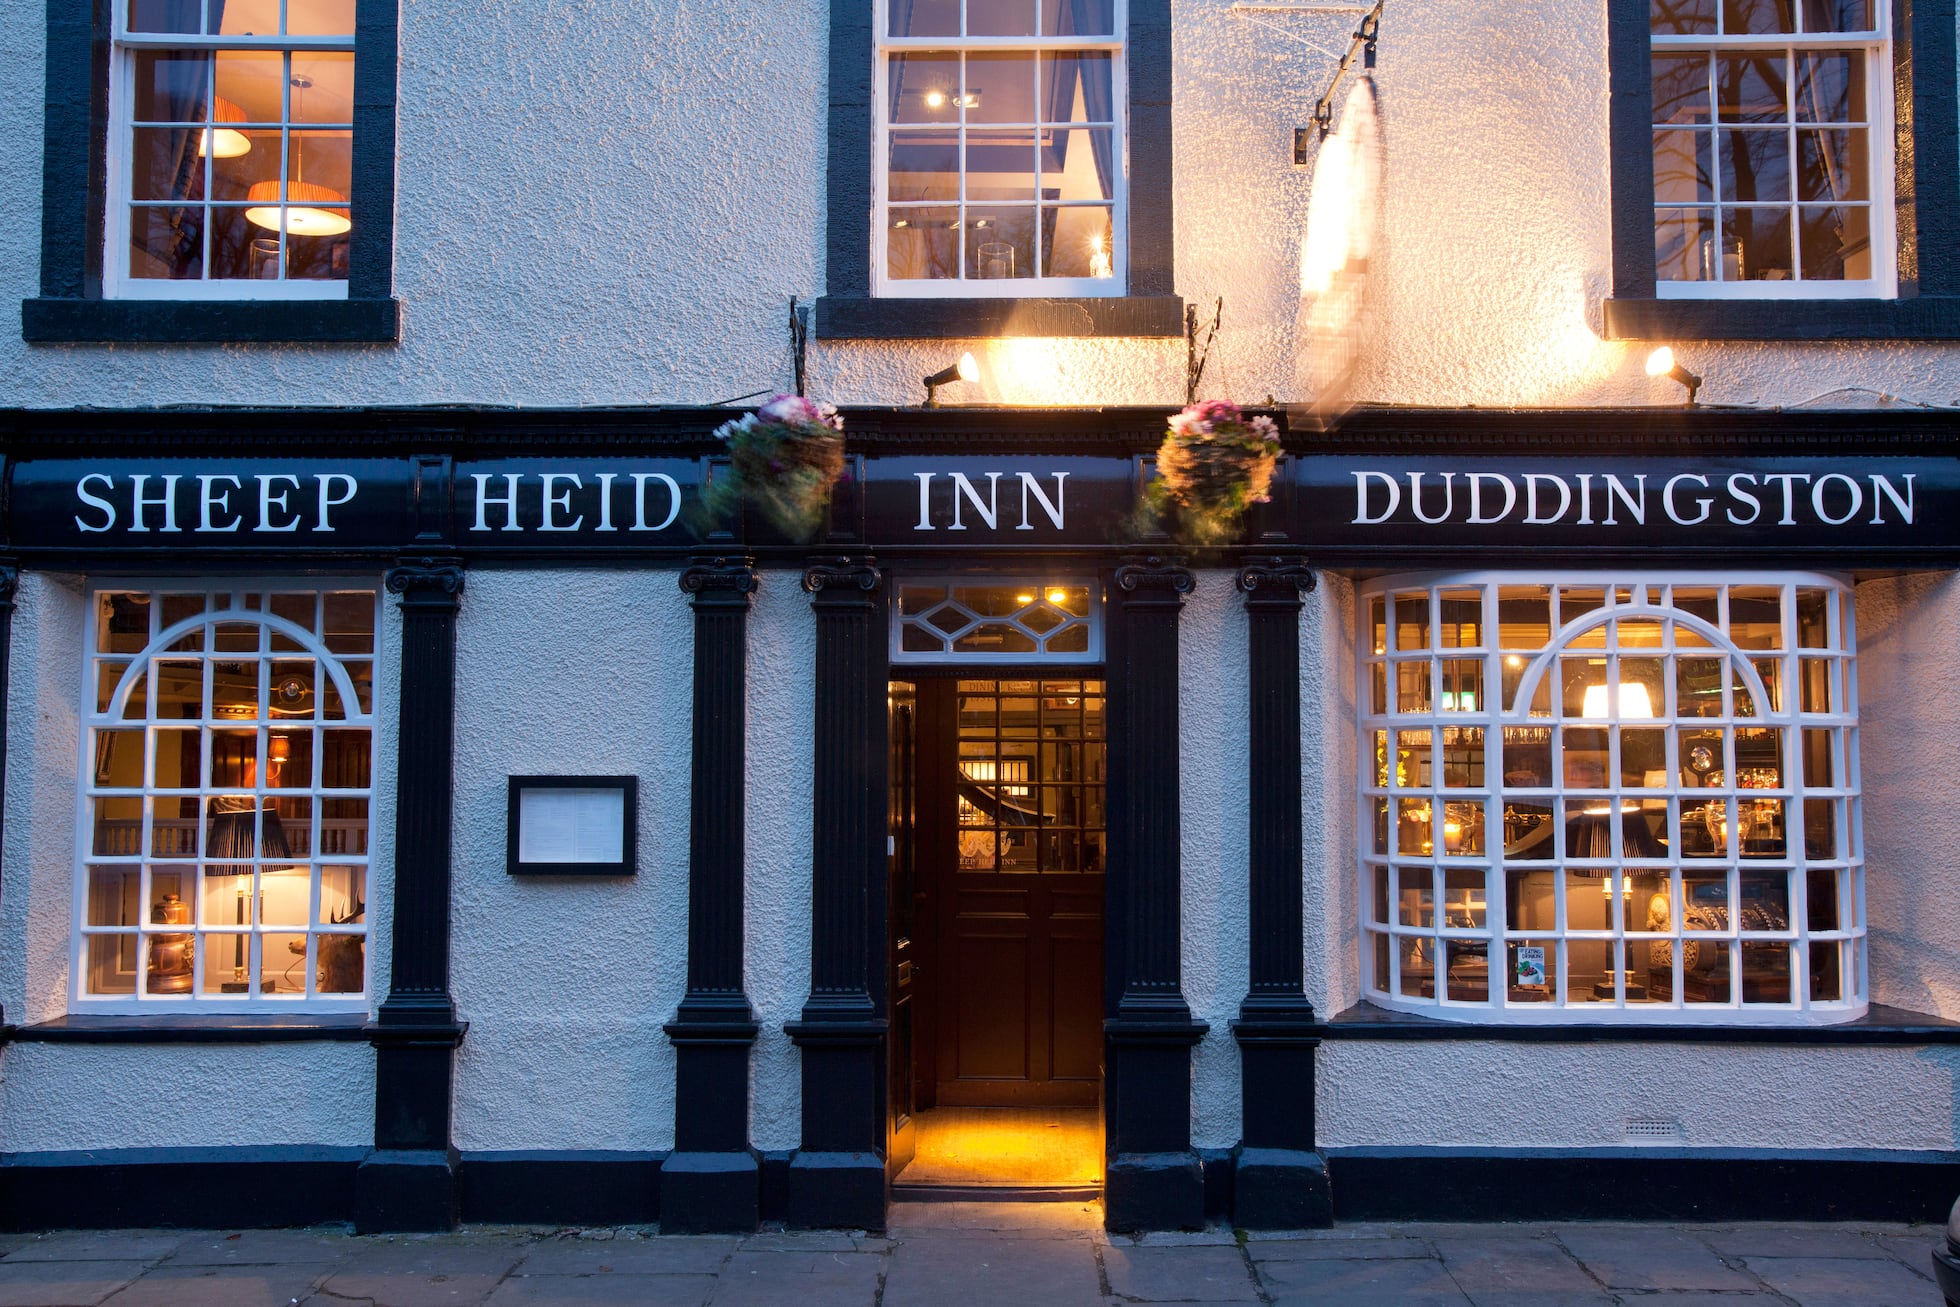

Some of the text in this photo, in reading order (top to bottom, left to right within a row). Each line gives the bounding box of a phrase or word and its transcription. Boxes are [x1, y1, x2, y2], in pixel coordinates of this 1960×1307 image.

[75, 471, 1917, 532] SHEEP HEID INN DUDDINGSTON
[969, 682, 996, 691] DININ
